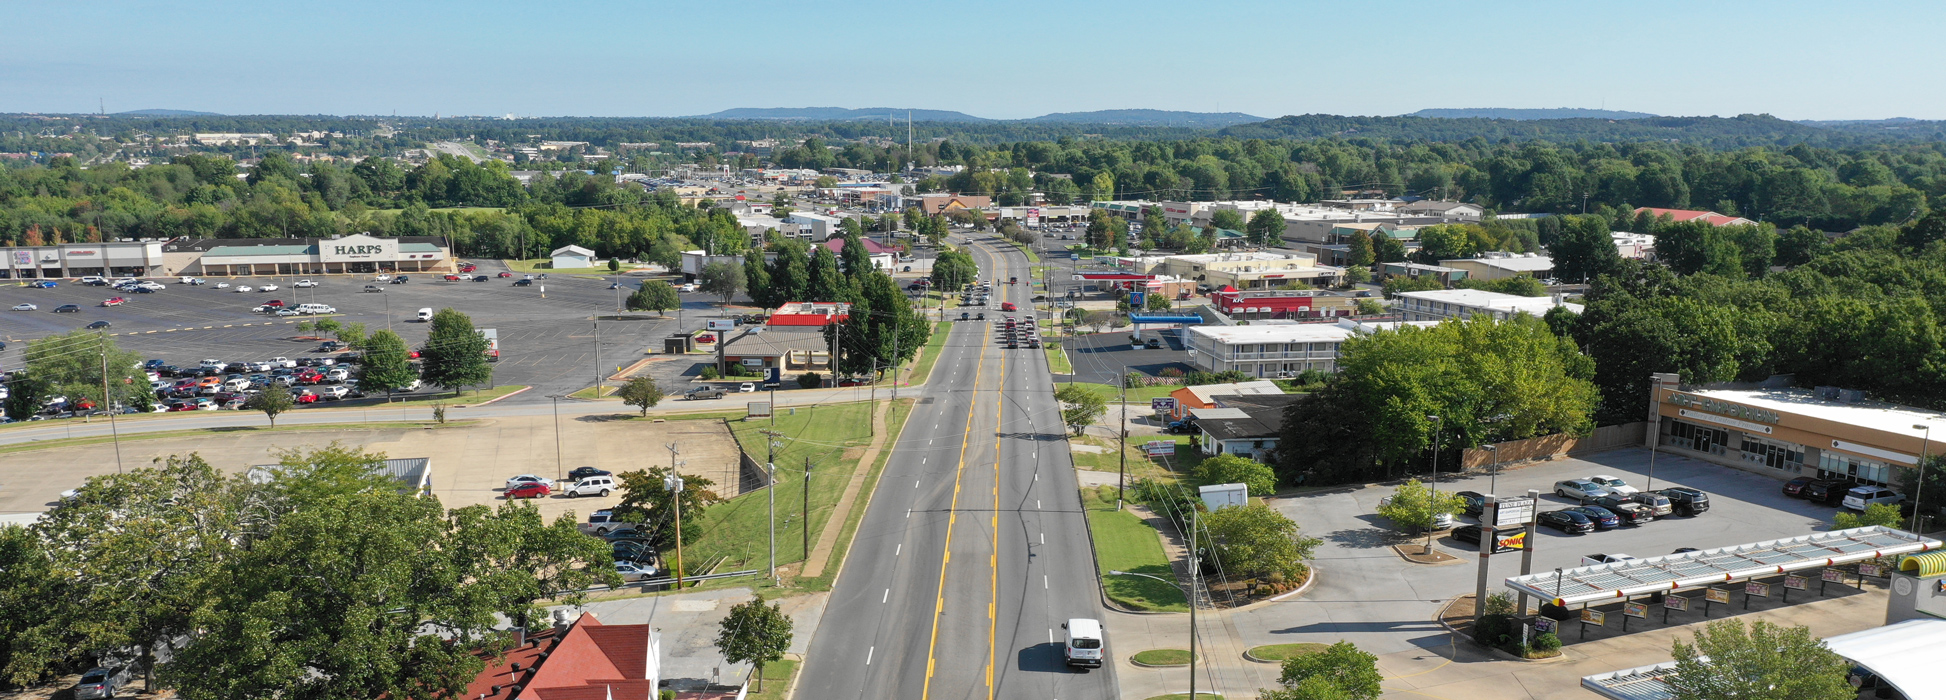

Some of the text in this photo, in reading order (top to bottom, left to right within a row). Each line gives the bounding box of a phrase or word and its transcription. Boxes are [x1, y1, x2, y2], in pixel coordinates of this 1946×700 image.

[334, 245, 382, 255] HARPS
[1133, 293, 1141, 304] 6
[1668, 392, 1778, 424] ART EMPORIUM
[1499, 537, 1525, 547] SONIC
